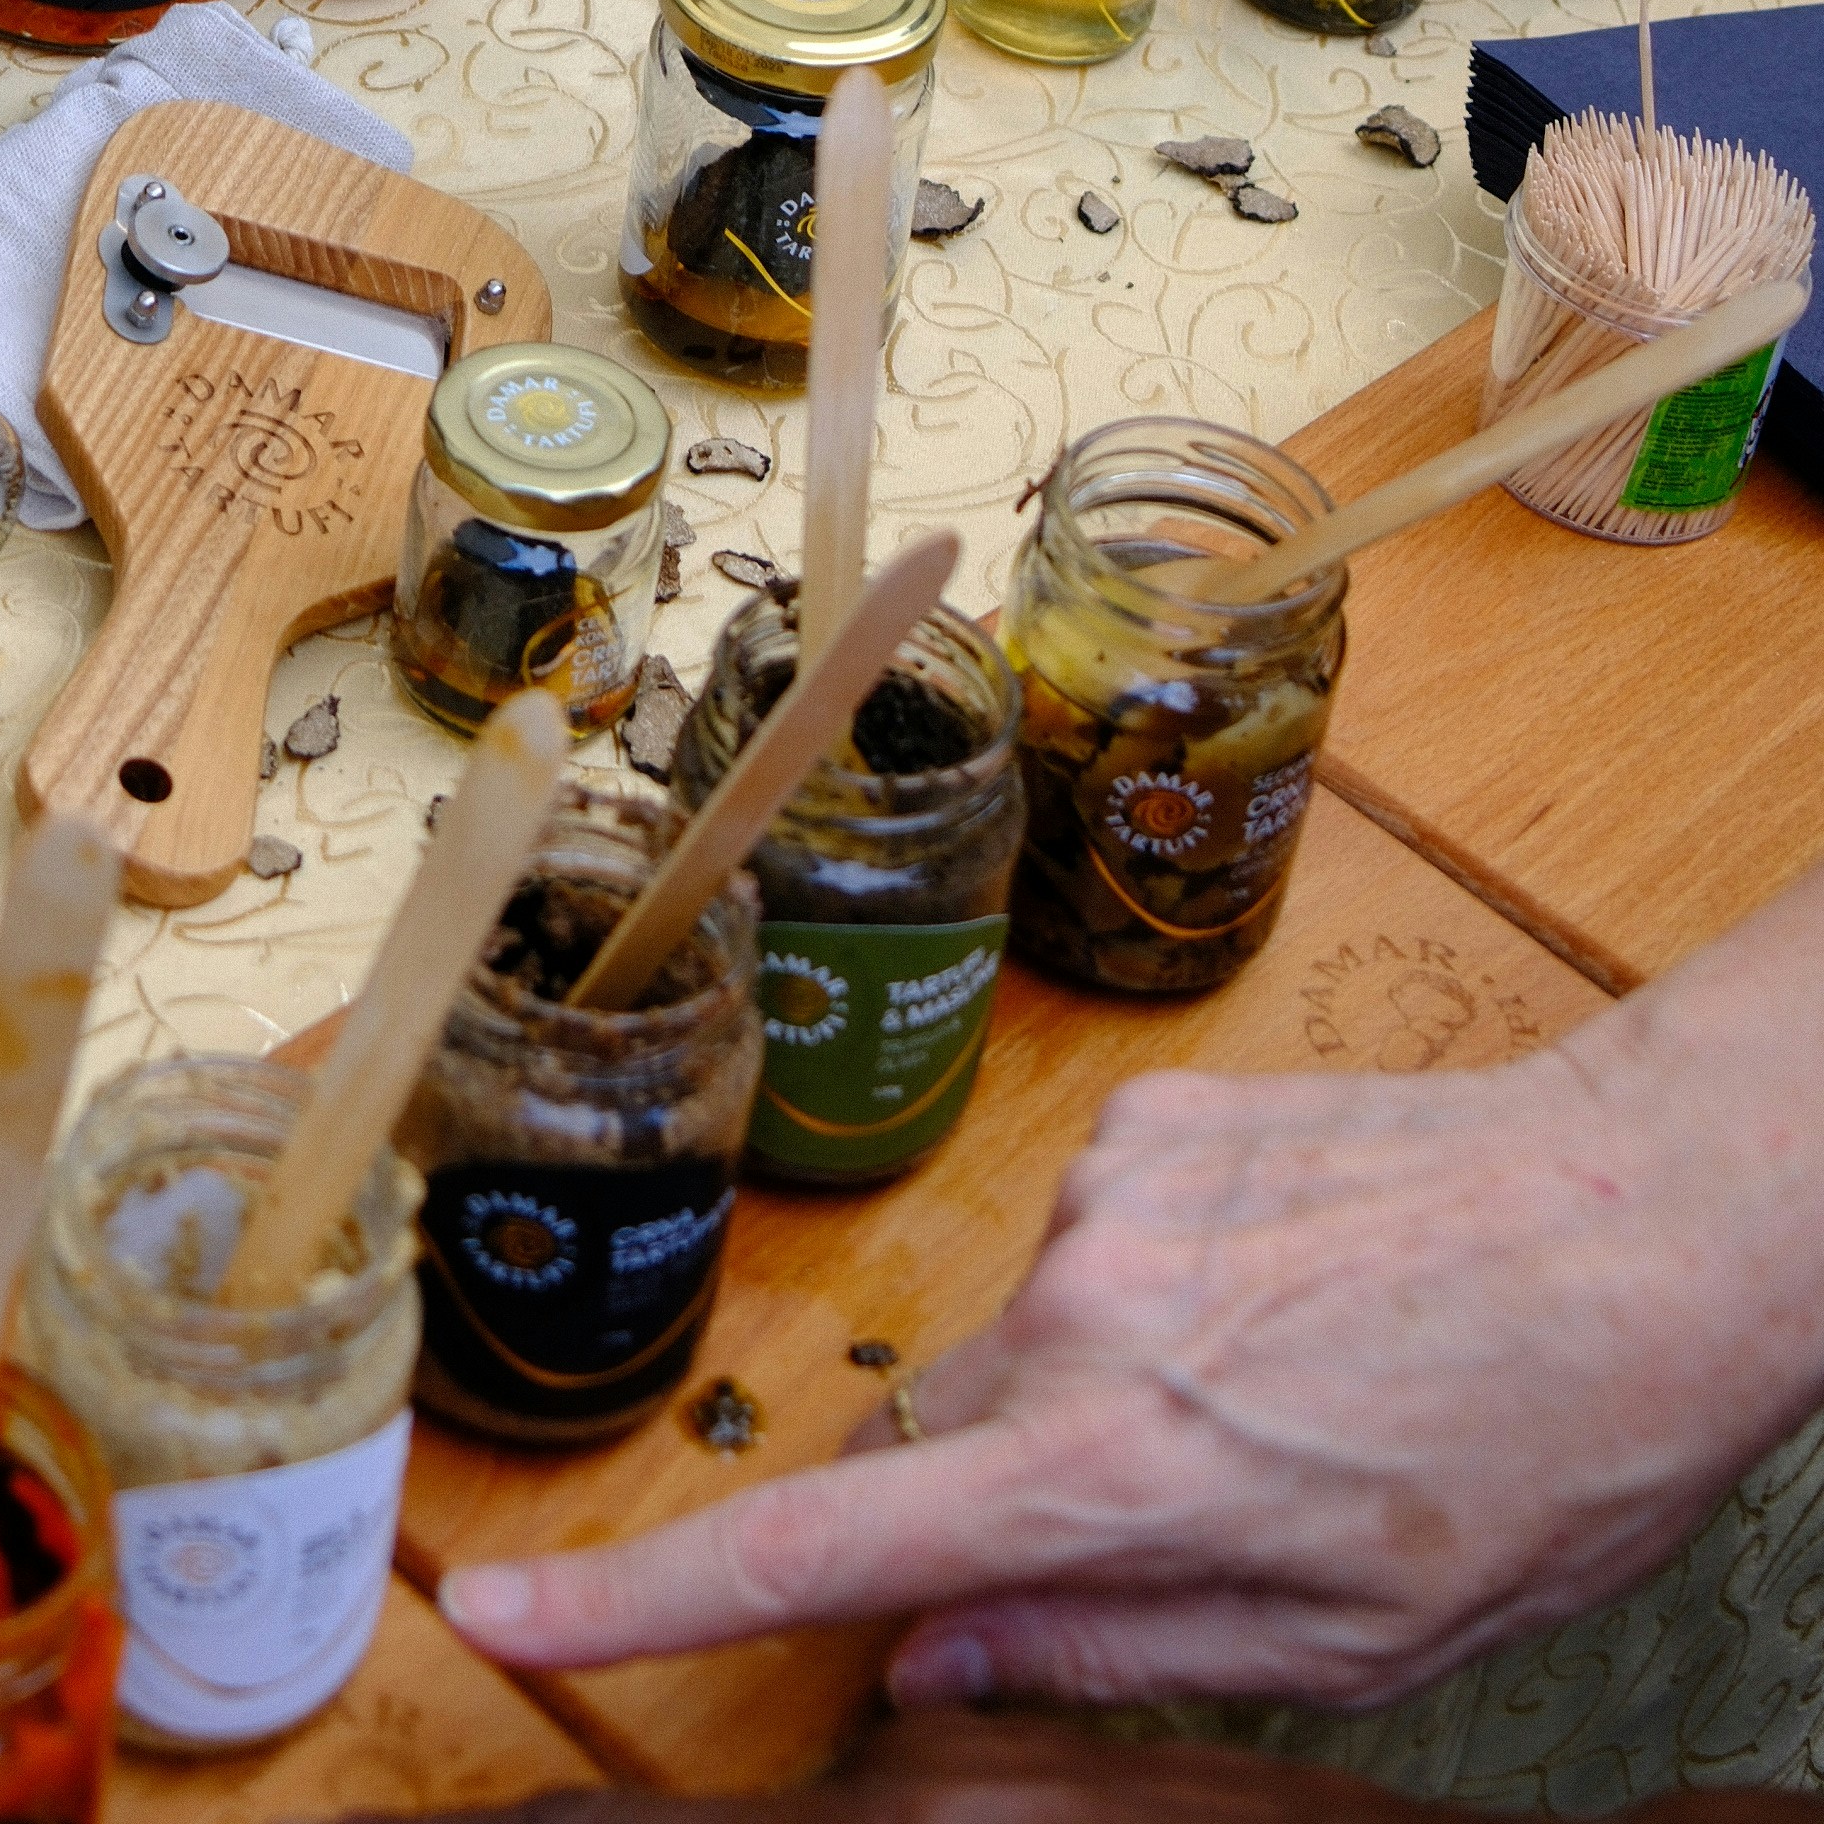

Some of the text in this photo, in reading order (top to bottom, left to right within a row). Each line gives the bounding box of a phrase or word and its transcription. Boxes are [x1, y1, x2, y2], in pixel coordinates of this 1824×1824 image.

[176, 369, 366, 459] DAMAR
[485, 375, 560, 424] DAMAR
[158, 436, 355, 537] TARTUFI
[1111, 769, 1216, 811] DAMAR
